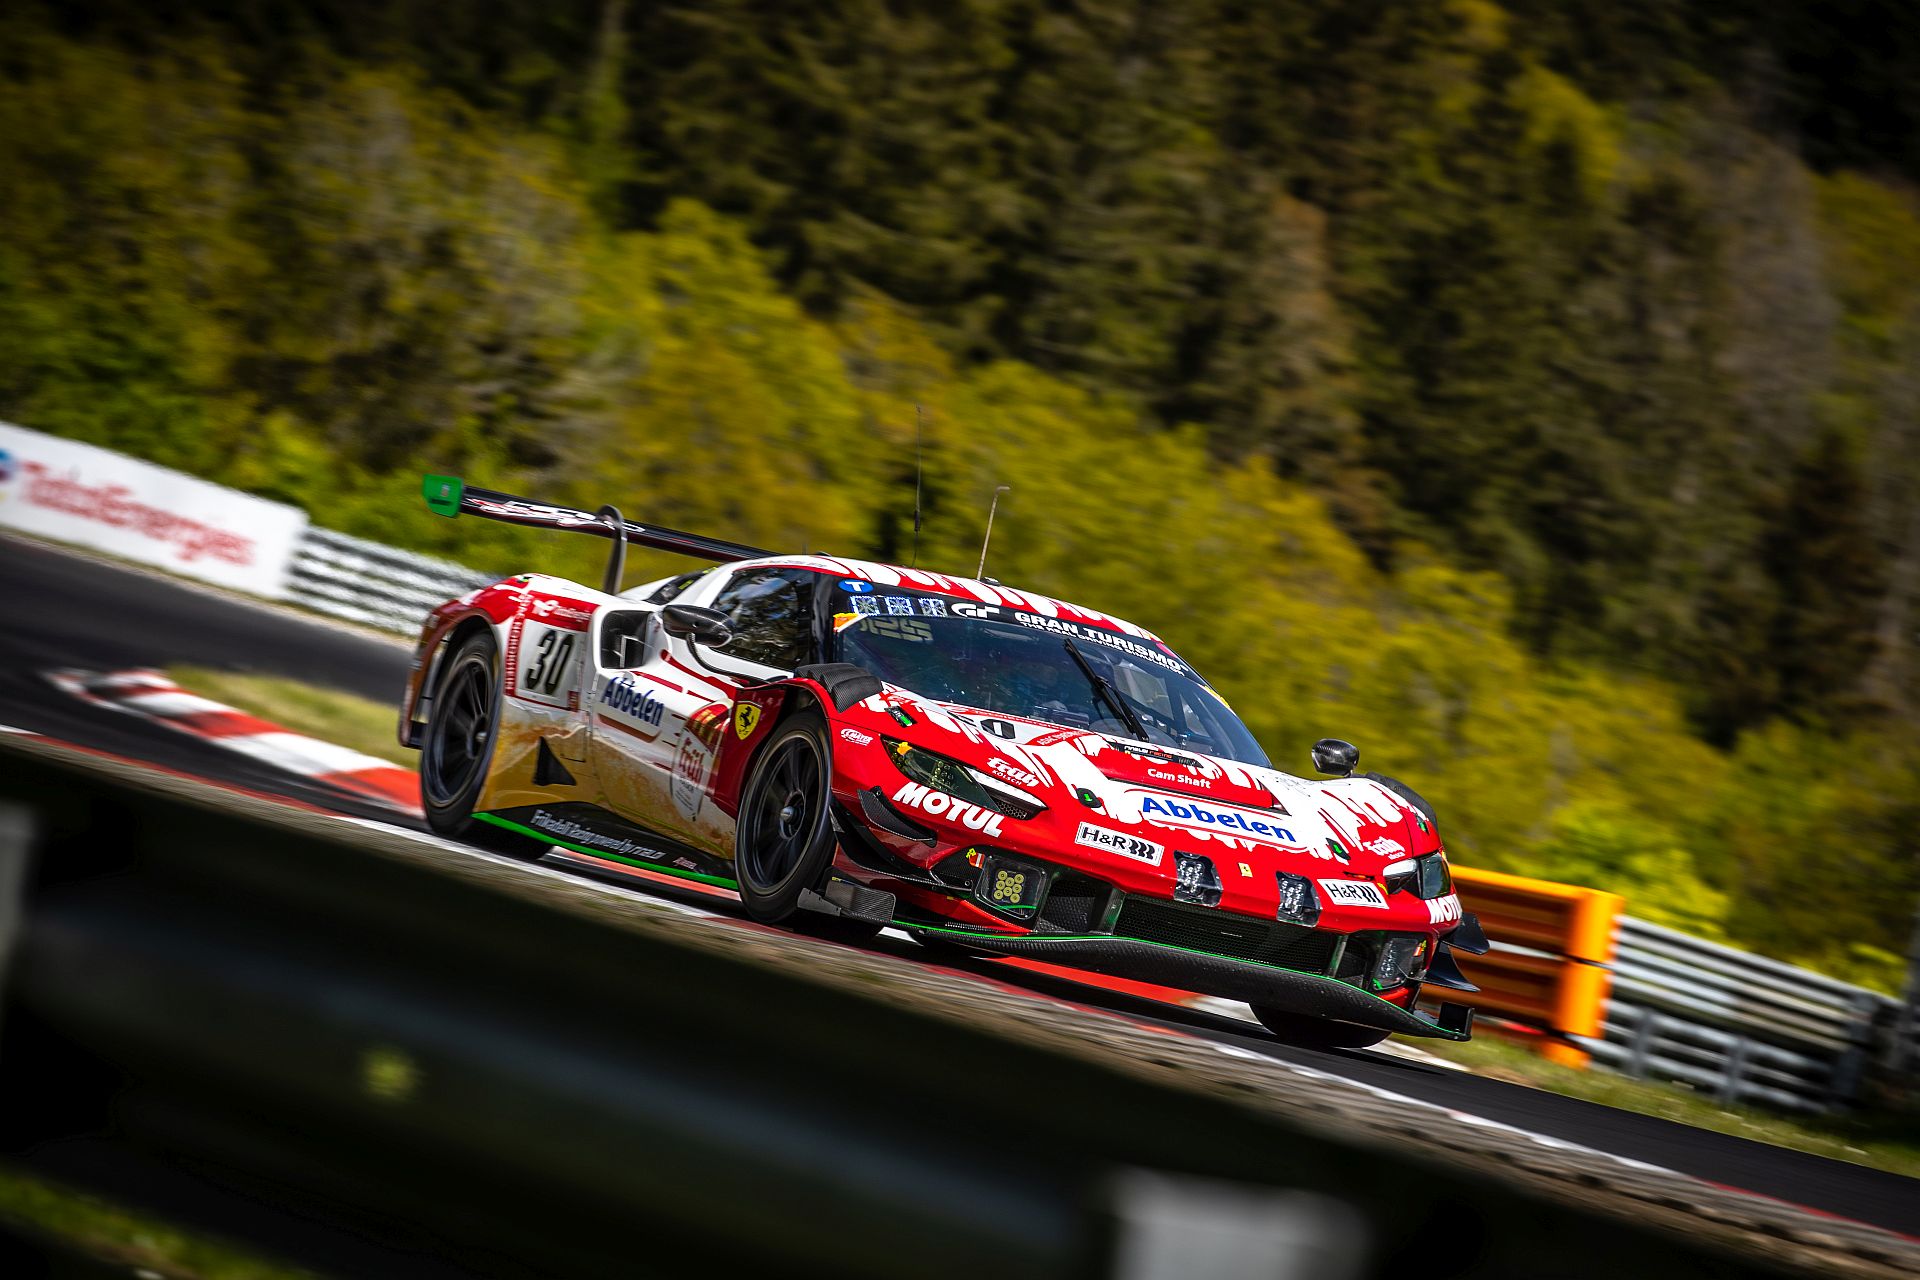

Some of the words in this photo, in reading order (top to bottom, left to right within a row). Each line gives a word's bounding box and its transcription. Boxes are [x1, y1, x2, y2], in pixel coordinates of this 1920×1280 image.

[844, 581, 865, 592] T
[1014, 611, 1079, 634] GRAN
[1083, 627, 1182, 671] TURISMO
[1020, 621, 1044, 630] THE
[526, 629, 575, 696] 30
[600, 676, 665, 727] Abbelen
[1147, 768, 1175, 782] Cam
[1177, 774, 1211, 789] Shaft
[892, 782, 1005, 838] MOTUL
[1142, 797, 1297, 843] Abbelen
[1082, 827, 1127, 849] H&R
